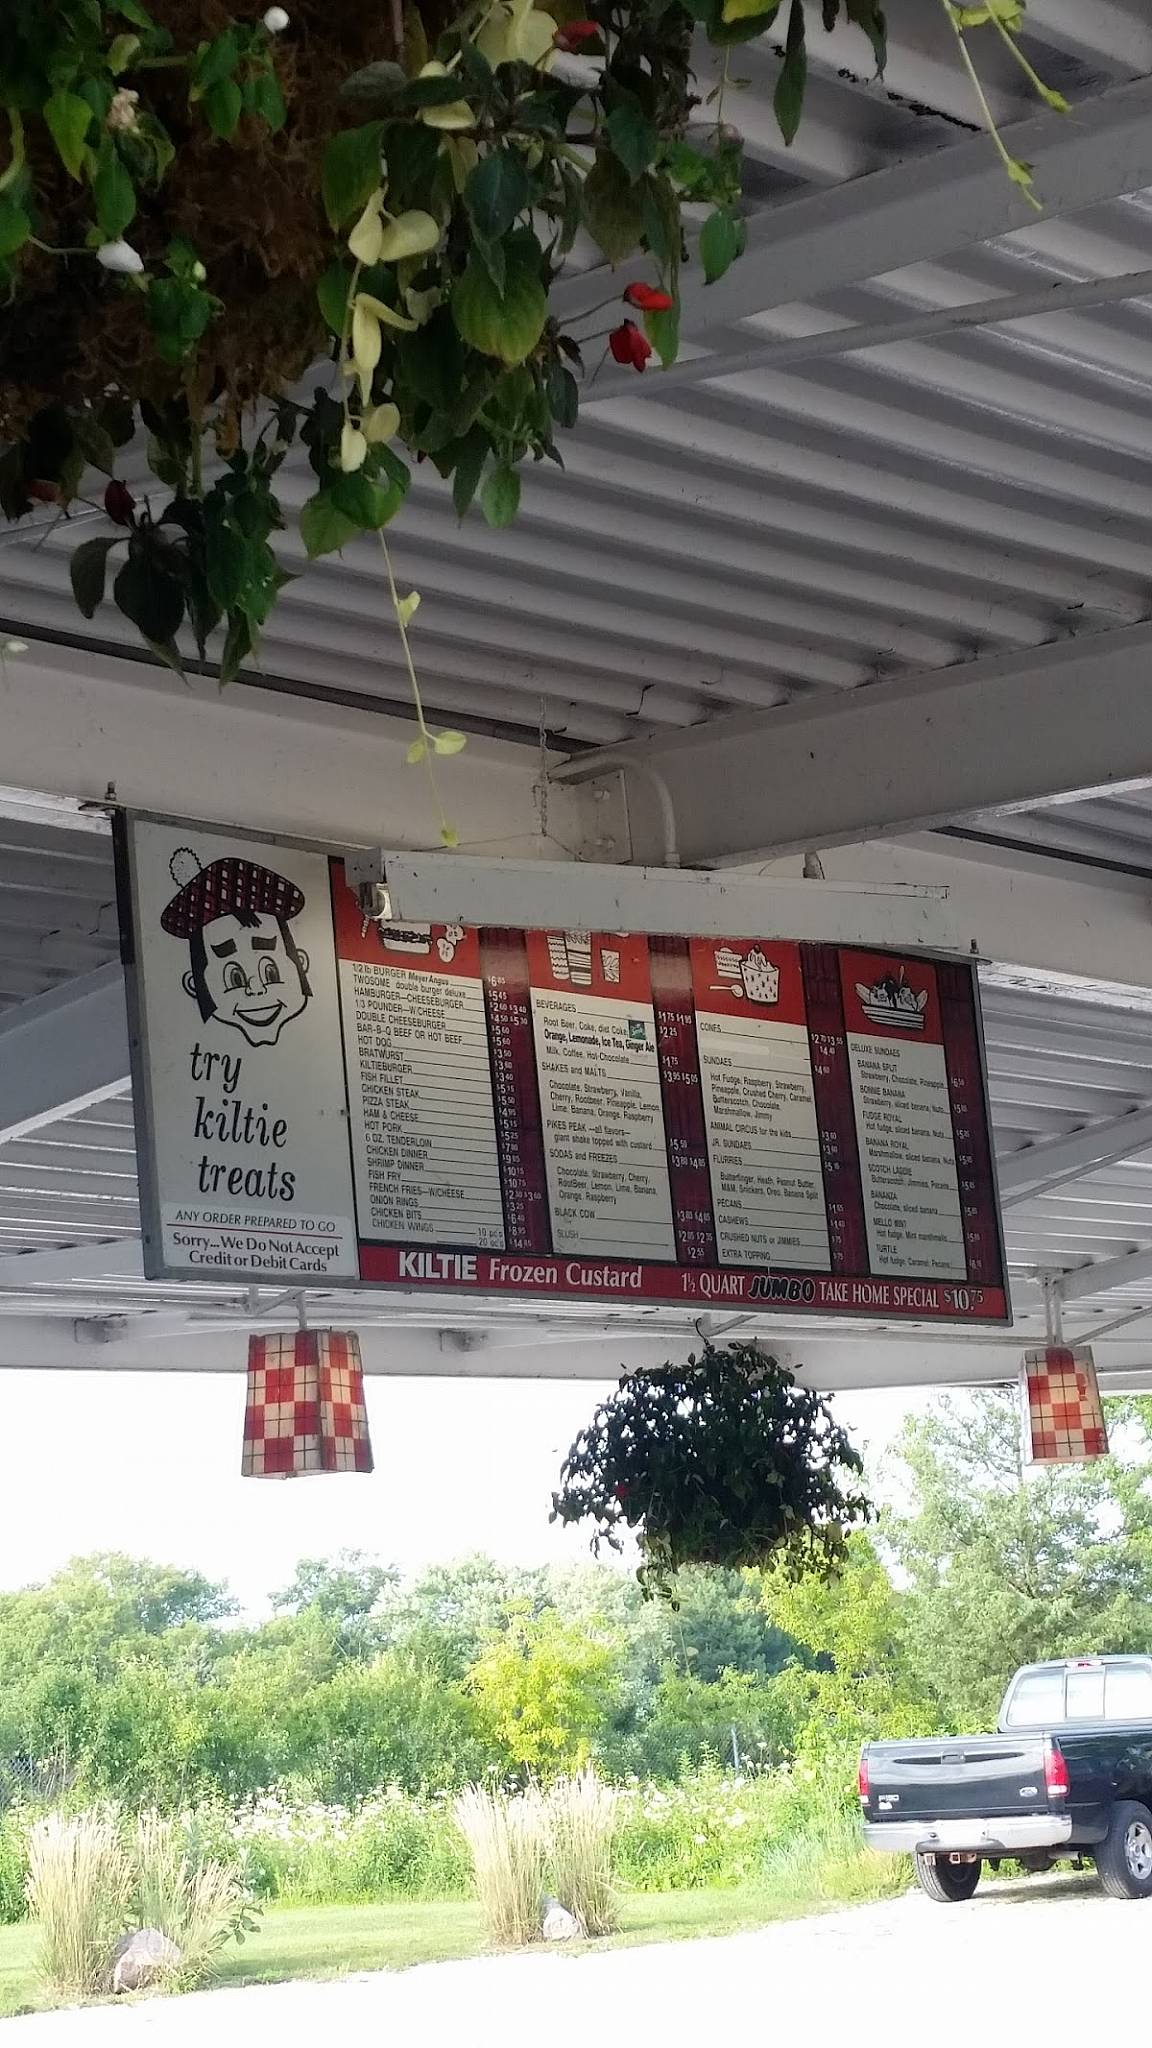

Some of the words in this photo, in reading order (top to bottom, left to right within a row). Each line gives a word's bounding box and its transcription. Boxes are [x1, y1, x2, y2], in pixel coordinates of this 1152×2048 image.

[373, 966, 406, 979] BURGER
[353, 973, 390, 987] TWOSOME
[395, 979, 418, 991] double
[420, 984, 442, 997] burger
[444, 986, 466, 998] deluxe
[535, 998, 577, 1013] BEVERAGES
[355, 1010, 385, 1023] DOUBLE
[388, 1014, 446, 1031] CHEESEBURGER
[542, 1016, 559, 1027] Root
[699, 1021, 722, 1033] CONES
[357, 1034, 373, 1045] HOT
[375, 1036, 392, 1047] DOG
[393, 1027, 412, 1038] BEEF
[414, 1029, 426, 1040] OR
[427, 1031, 442, 1042] HOT
[444, 1033, 463, 1045] BEEF
[543, 1028, 568, 1044] Orange,
[567, 1031, 600, 1048] Lemonade,
[601, 1036, 611, 1047] Ice
[625, 1039, 645, 1053] Ginger
[358, 1046, 404, 1061] BRATWURST
[849, 1042, 872, 1053] DELUXE
[873, 1045, 900, 1057] SUNDAES
[359, 1059, 413, 1074] KILTIEBURGER
[702, 1054, 732, 1066] SUNDAES
[856, 1058, 880, 1070] BANANA
[190, 1043, 242, 1093] try
[541, 1061, 568, 1073] SHAKES
[570, 1065, 582, 1074] and
[583, 1066, 607, 1077] MALTS
[360, 1071, 377, 1082] FISH
[379, 1073, 403, 1085] FILLET
[710, 1072, 721, 1081] Hot
[361, 1083, 394, 1095] CHICKEN
[395, 1087, 420, 1098] STEAK
[882, 1087, 905, 1098] BANANA
[361, 1095, 383, 1106] PIZZA
[385, 1098, 409, 1109] STEAK
[362, 1107, 380, 1118] HAM
[381, 1109, 388, 1119] &
[390, 1110, 419, 1122] CHEESE
[861, 1110, 882, 1120] FUDGE
[193, 1097, 287, 1148] kiltie
[363, 1120, 380, 1130] HOT
[381, 1122, 402, 1132] PORK
[546, 1119, 567, 1130] PIKES
[567, 1121, 586, 1132] PEAK
[709, 1120, 733, 1132] ANIMAL
[735, 1123, 757, 1134] CIRCUS
[364, 1132, 370, 1142] 6
[386, 1134, 432, 1148] TENDERLOIN
[722, 1138, 752, 1149] SUNDAES
[365, 1144, 399, 1156] CHICKEN
[400, 1147, 427, 1159] DINNER
[549, 1148, 573, 1159] SODAS
[574, 1150, 586, 1160] and
[588, 1152, 618, 1163] FREEZES
[366, 1156, 395, 1168] SHRIMP
[396, 1159, 424, 1171] DINNER
[712, 1153, 743, 1166] FLURRIES
[198, 1156, 296, 1201] treats
[367, 1169, 385, 1179] FISH
[386, 1171, 401, 1181] FRY
[368, 1181, 399, 1193] FRENCH
[369, 1194, 394, 1205] ONION
[395, 1196, 418, 1207] RINGS
[716, 1198, 742, 1208] PECANS
[370, 1206, 404, 1218] CHICKEN
[405, 1209, 422, 1220] BITS
[553, 1207, 576, 1217] BLACK
[578, 1209, 595, 1219] COW
[718, 1214, 749, 1225] CASHEWS
[176, 1210, 200, 1222] ANY
[202, 1212, 241, 1224] ORDER
[244, 1215, 297, 1229] PREPARED
[300, 1219, 314, 1231] TO
[318, 1222, 336, 1232] GO
[371, 1218, 405, 1229] CHICKEN
[406, 1221, 434, 1232] WINGS
[556, 1228, 578, 1239] SLUSH
[719, 1231, 749, 1242] CRUSHED
[750, 1233, 767, 1243] NUTS
[247, 1238, 266, 1250] Do
[269, 1240, 294, 1253] Not
[295, 1242, 340, 1260] Accept
[721, 1248, 742, 1258] EXTRA
[743, 1249, 771, 1260] TOPPING
[189, 1250, 232, 1265] Credit
[234, 1256, 249, 1266] or
[251, 1255, 287, 1269] Debit
[289, 1257, 327, 1272] Cards
[399, 1251, 477, 1280] KILTIE
[490, 1258, 557, 1283] Frozen
[566, 1262, 642, 1288] Custard
[700, 1273, 745, 1298] QUART
[748, 1275, 816, 1303] JUMBO
[819, 1281, 848, 1302] TAKE
[852, 1284, 890, 1306] HOME
[893, 1286, 939, 1309] SPECIAL
